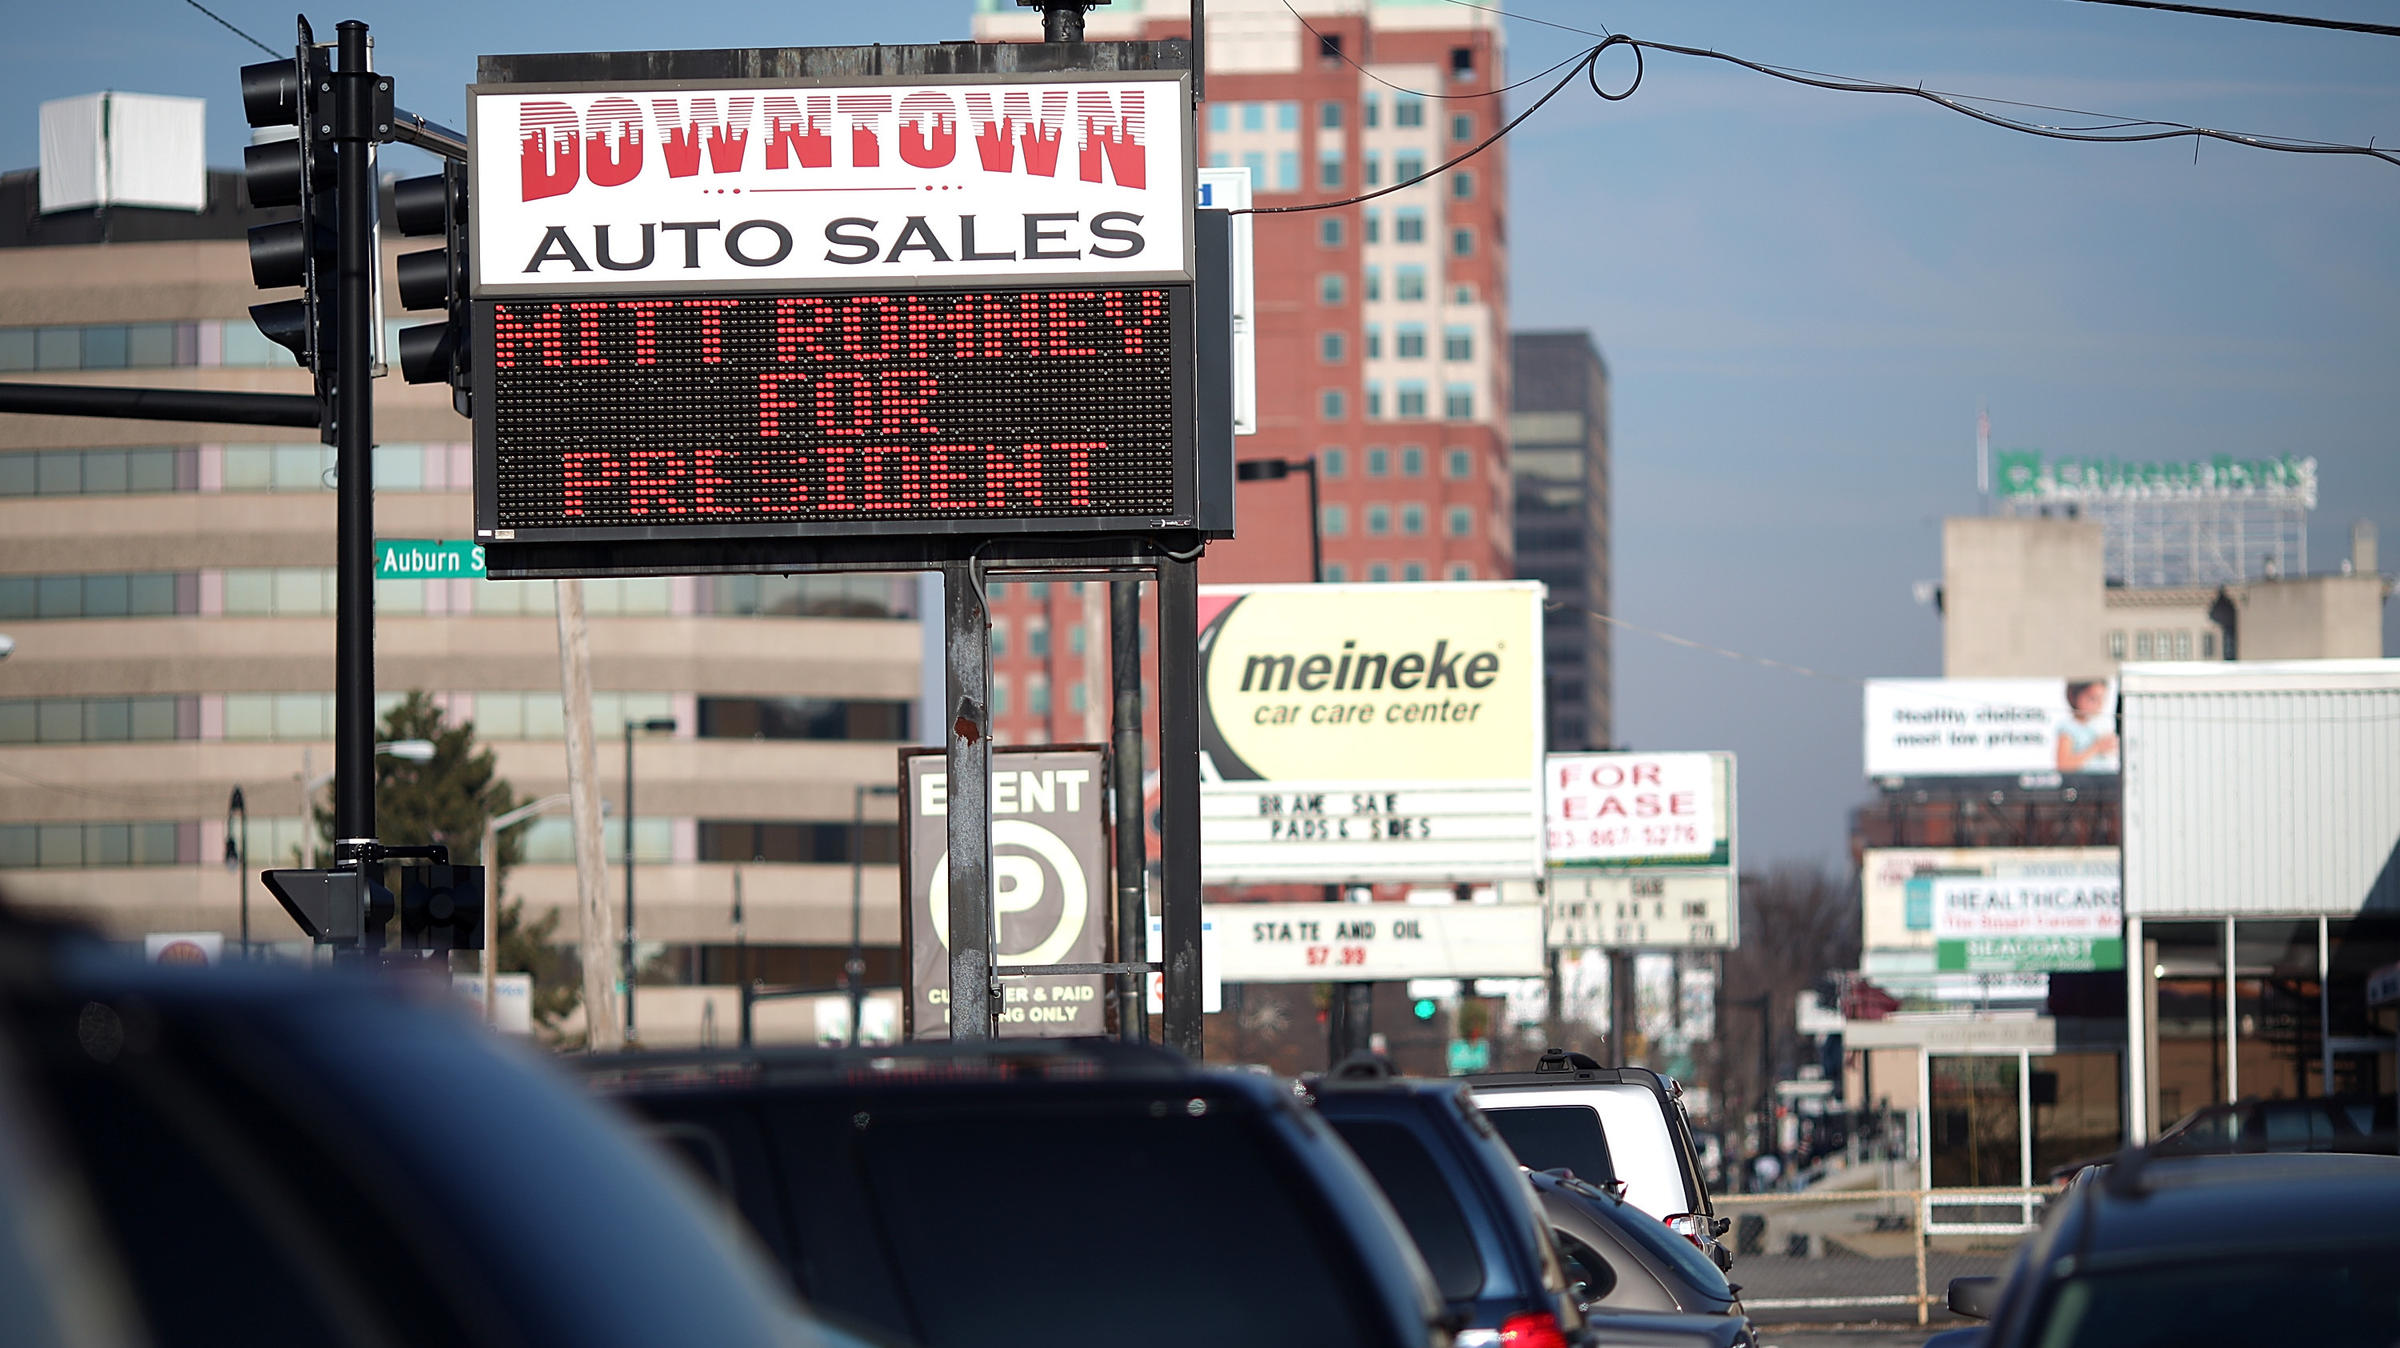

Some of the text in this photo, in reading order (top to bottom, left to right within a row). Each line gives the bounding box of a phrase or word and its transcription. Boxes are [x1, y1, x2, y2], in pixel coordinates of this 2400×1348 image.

[520, 90, 1147, 203] DOWNTOWN
[521, 210, 1146, 273] AUTO SALES
[495, 290, 1162, 368] MITT ROMNEY
[759, 370, 939, 437] FOR
[563, 442, 1108, 516] PRESIDENT
[383, 546, 485, 572] Auburn S
[1239, 638, 1500, 692] meineke
[1254, 698, 1482, 725] car care center
[1560, 762, 1662, 790] FOR
[920, 769, 1090, 816] EENT
[1555, 791, 1697, 821] EASE
[1271, 818, 1328, 840] PADS
[1252, 922, 1320, 941] STATE
[1393, 920, 1423, 939] OIL
[1033, 987, 1048, 1002] &
[1051, 985, 1094, 1002] PAID
[1029, 1005, 1078, 1023] ONLY
